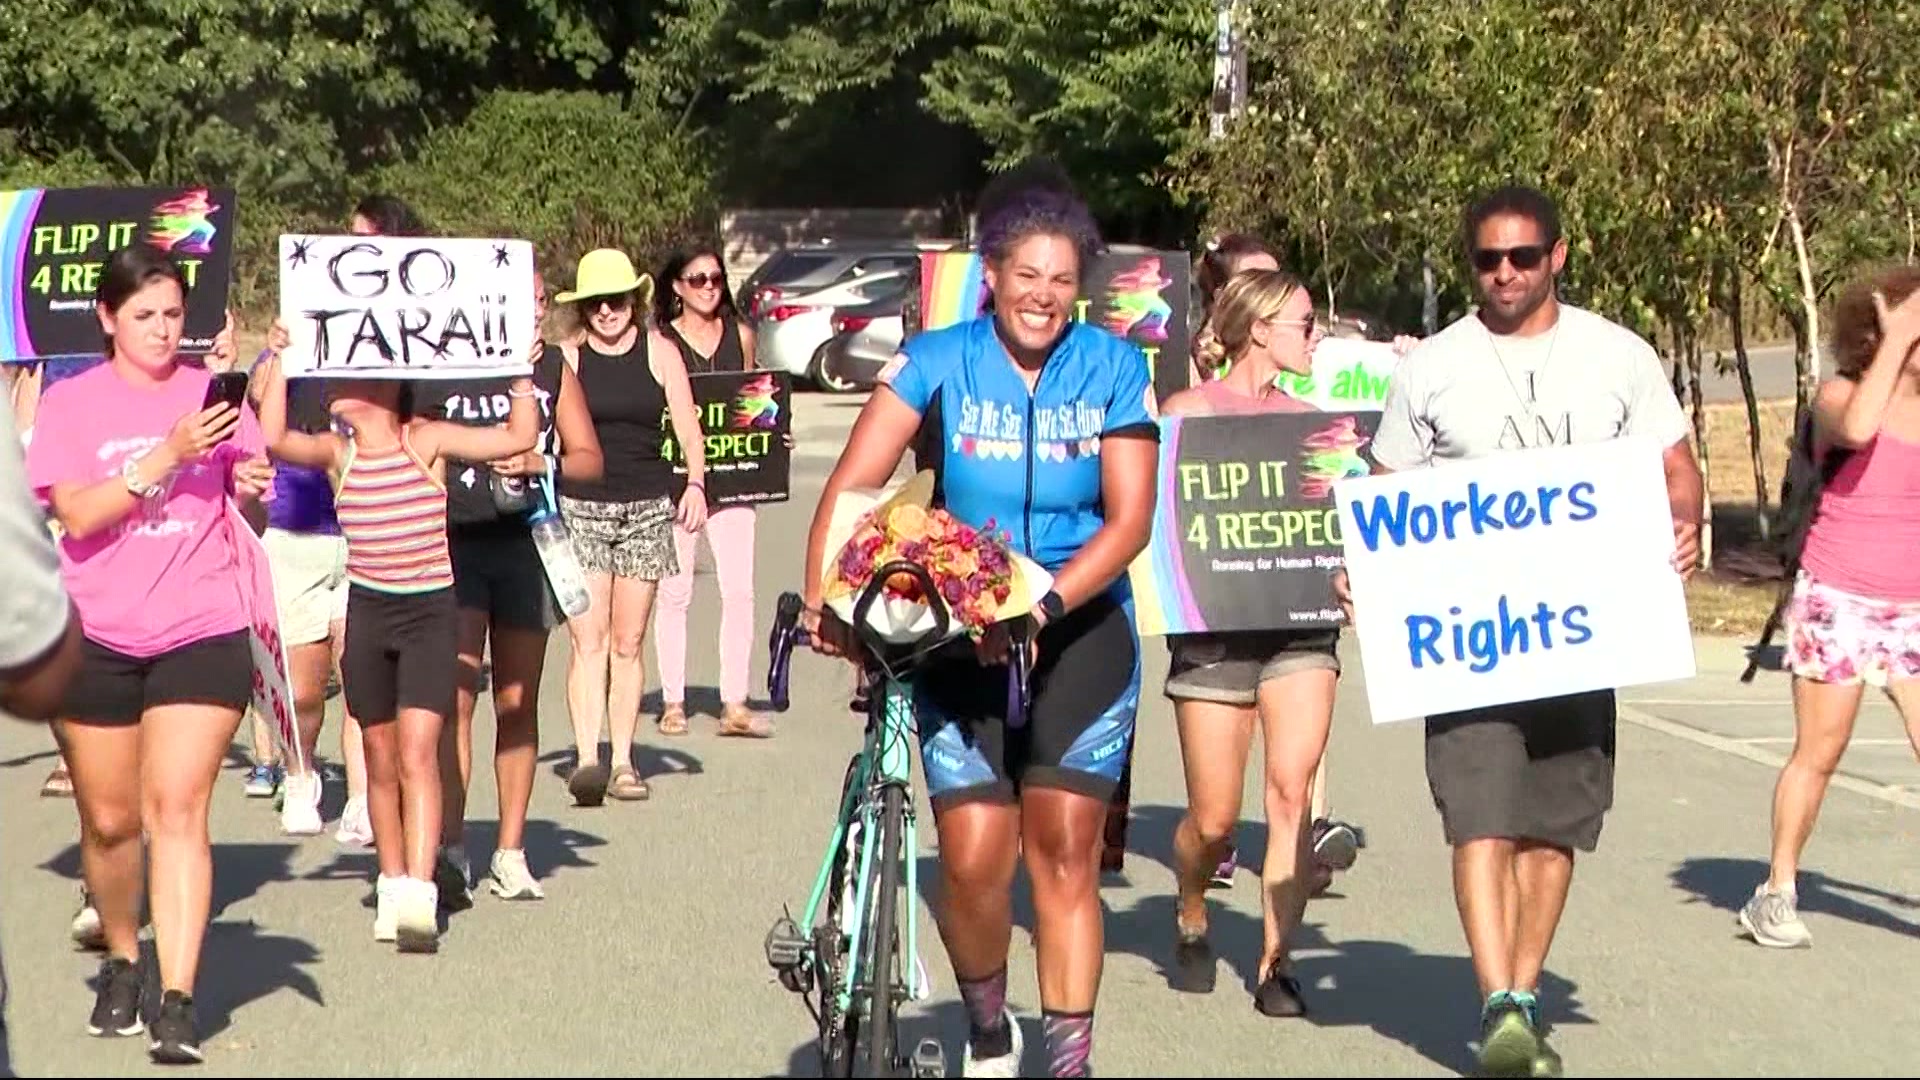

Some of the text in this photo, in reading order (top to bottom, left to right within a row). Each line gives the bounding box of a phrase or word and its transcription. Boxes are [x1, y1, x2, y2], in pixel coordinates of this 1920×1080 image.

[108, 221, 137, 251] IT
[30, 264, 51, 294] 4
[327, 243, 456, 298] GO
[300, 295, 512, 368] TARA!!
[1331, 361, 1392, 400] alw
[1525, 370, 1537, 402] I
[709, 402, 727, 427] IT
[1496, 411, 1573, 449] AM
[661, 438, 673, 461] 4
[460, 467, 476, 490] 4
[1259, 461, 1288, 497] IT
[1187, 508, 1344, 550] 4 RESPEC
[1351, 481, 1598, 551] Workers
[1275, 556, 1313, 569] Human
[1404, 594, 1593, 672] Rights
